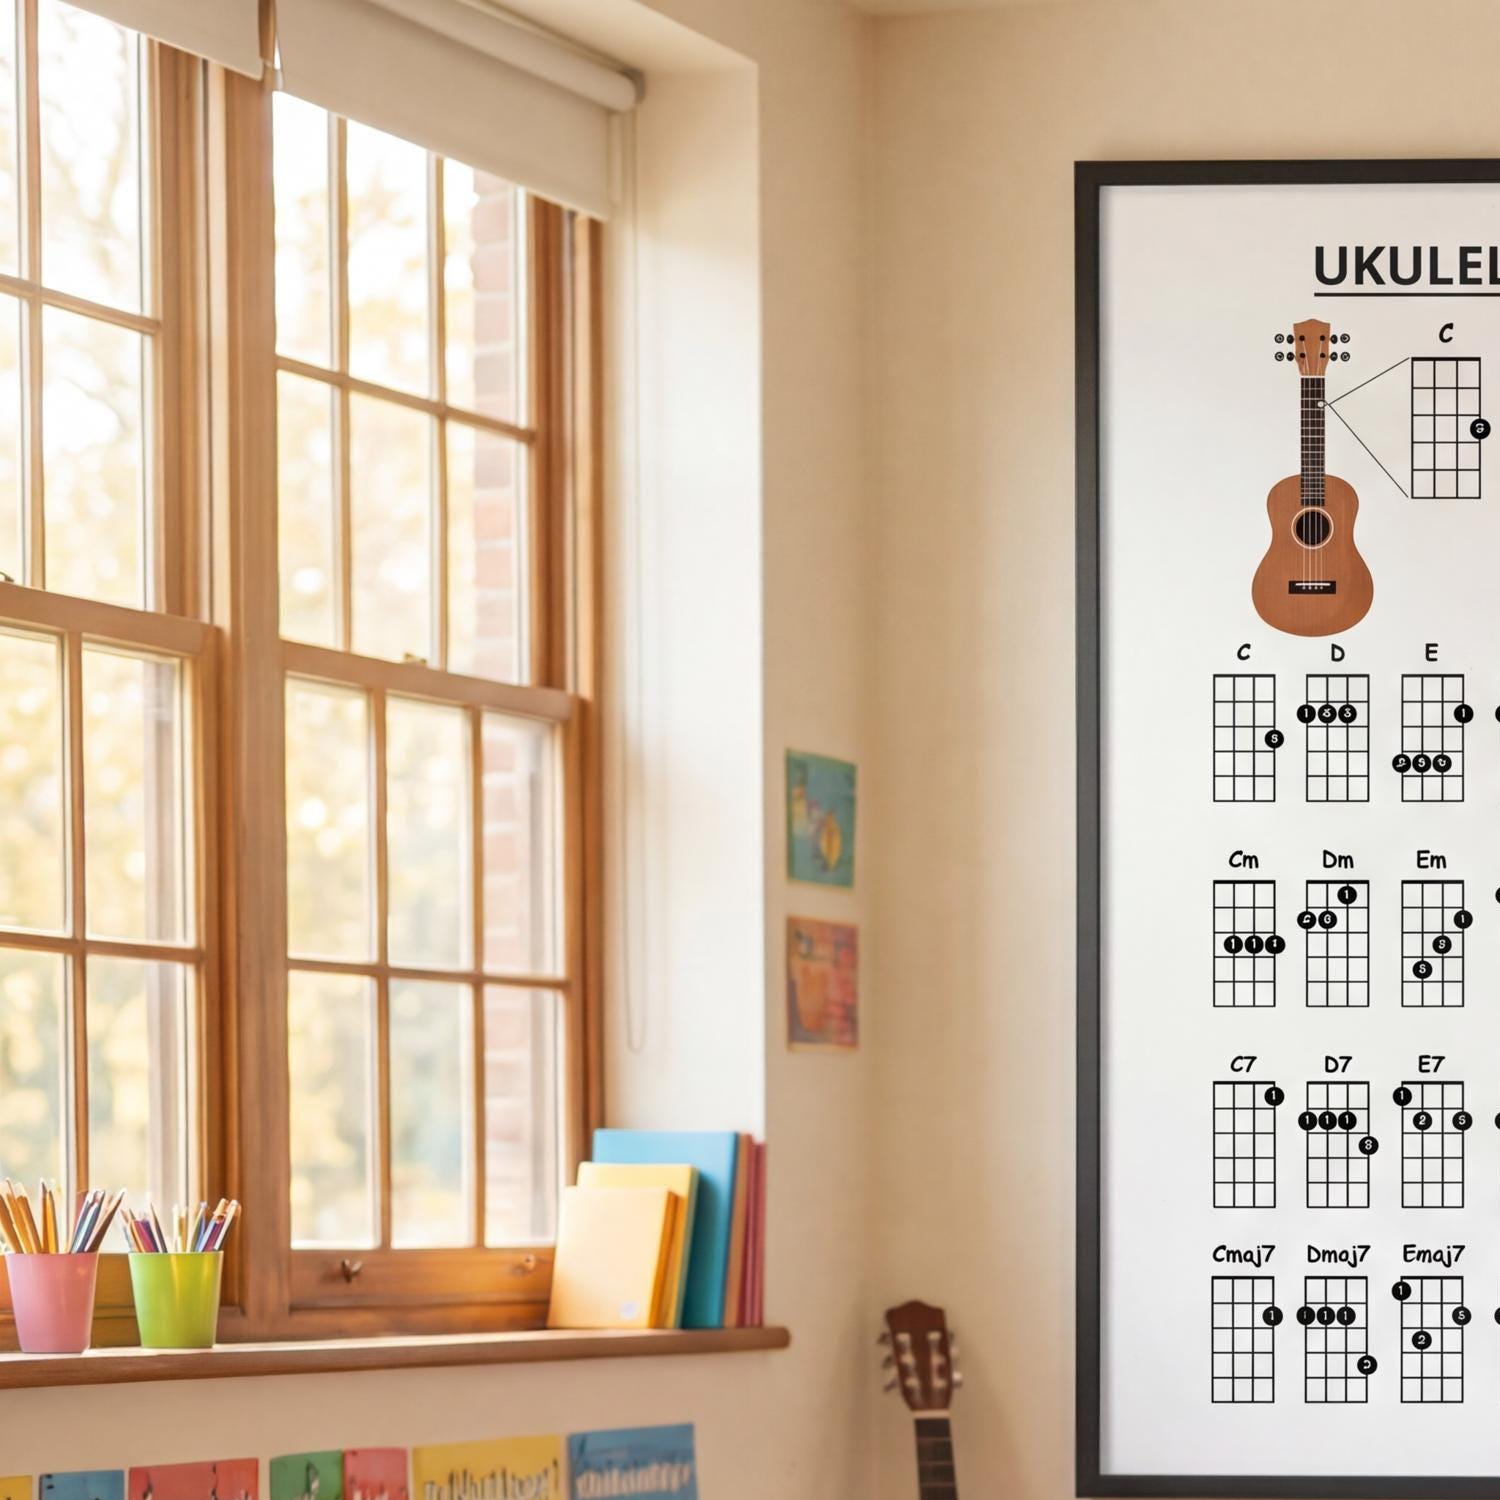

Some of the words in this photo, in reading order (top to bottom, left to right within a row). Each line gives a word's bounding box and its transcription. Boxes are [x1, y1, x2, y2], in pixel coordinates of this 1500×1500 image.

[1439, 323, 1453, 343] C
[1237, 644, 1250, 660] C
[1331, 644, 1345, 662] D
[1426, 643, 1438, 661] E
[1229, 850, 1258, 869] Cm
[1323, 850, 1353, 868] Dm
[1417, 850, 1446, 869] Em
[1231, 1056, 1257, 1072] C7
[1325, 1056, 1352, 1073] D7
[1419, 1055, 1445, 1073] E7
[1213, 1245, 1275, 1267] Cmaj7
[1308, 1245, 1370, 1268] Dmaj7
[1403, 1244, 1465, 1268] Emaj7
